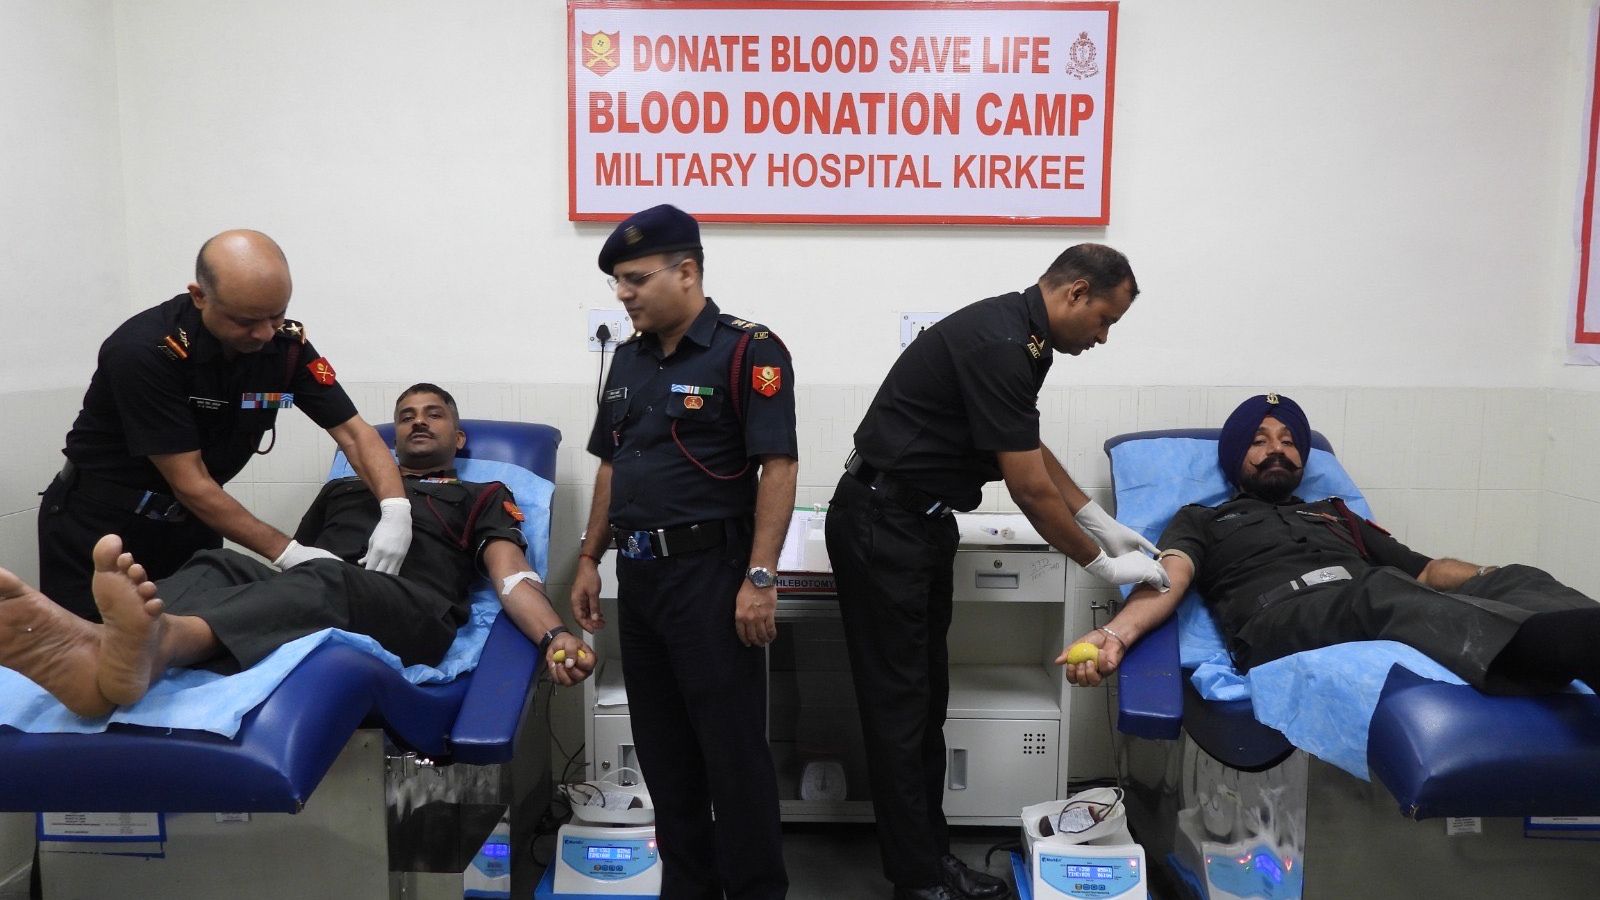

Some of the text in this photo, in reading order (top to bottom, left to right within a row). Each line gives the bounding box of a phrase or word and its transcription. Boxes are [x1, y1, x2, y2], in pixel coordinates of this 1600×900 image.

[633, 35, 1050, 74] DONATE BLOOD SAVE LIFE
[589, 91, 1095, 137] BLOOD DONATION CAMP
[595, 152, 1085, 190] MILITARY HOSPITAL KIRKEE
[776, 579, 834, 588] HLEBOTOMY
